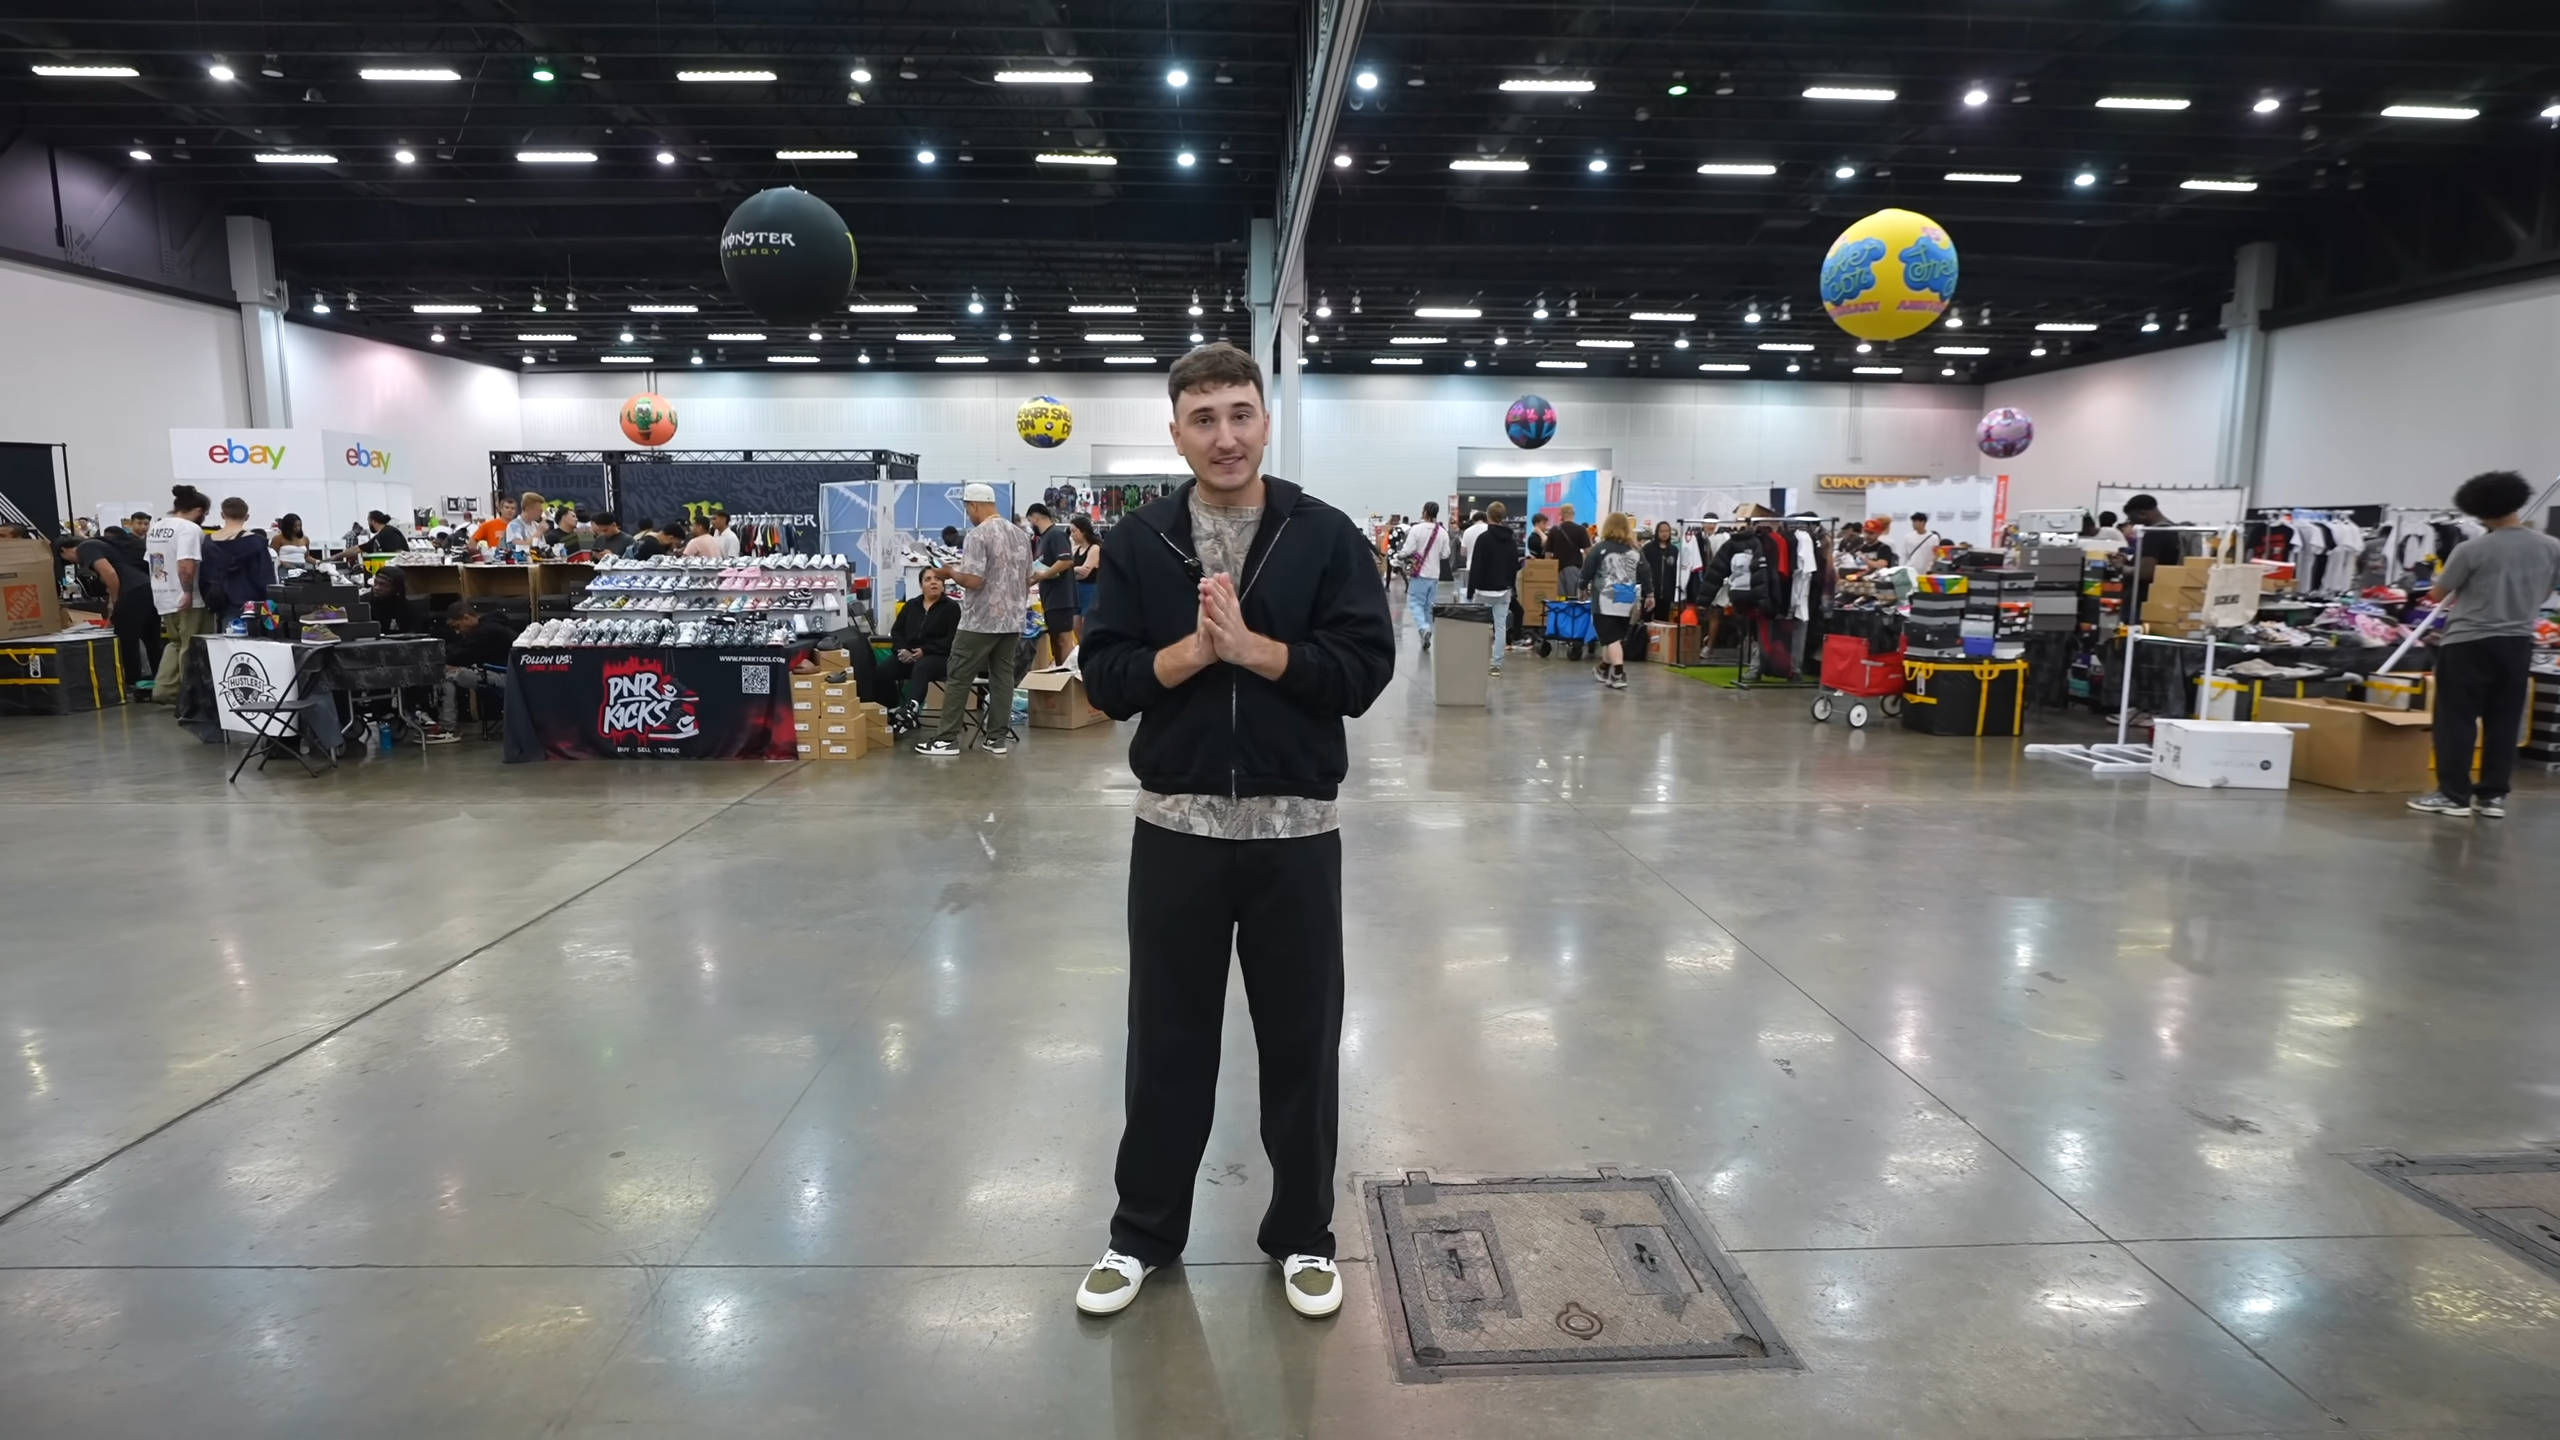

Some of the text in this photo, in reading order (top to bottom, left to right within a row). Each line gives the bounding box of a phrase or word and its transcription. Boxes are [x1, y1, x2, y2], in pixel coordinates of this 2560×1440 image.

[722, 231, 796, 250] MONSTER
[726, 248, 781, 258] ENERGY
[208, 438, 286, 470] ebay
[346, 442, 391, 474] ebay
[520, 654, 573, 665] FOLLOW US!
[229, 677, 262, 690] HUSTLERS
[608, 672, 662, 706] PNR
